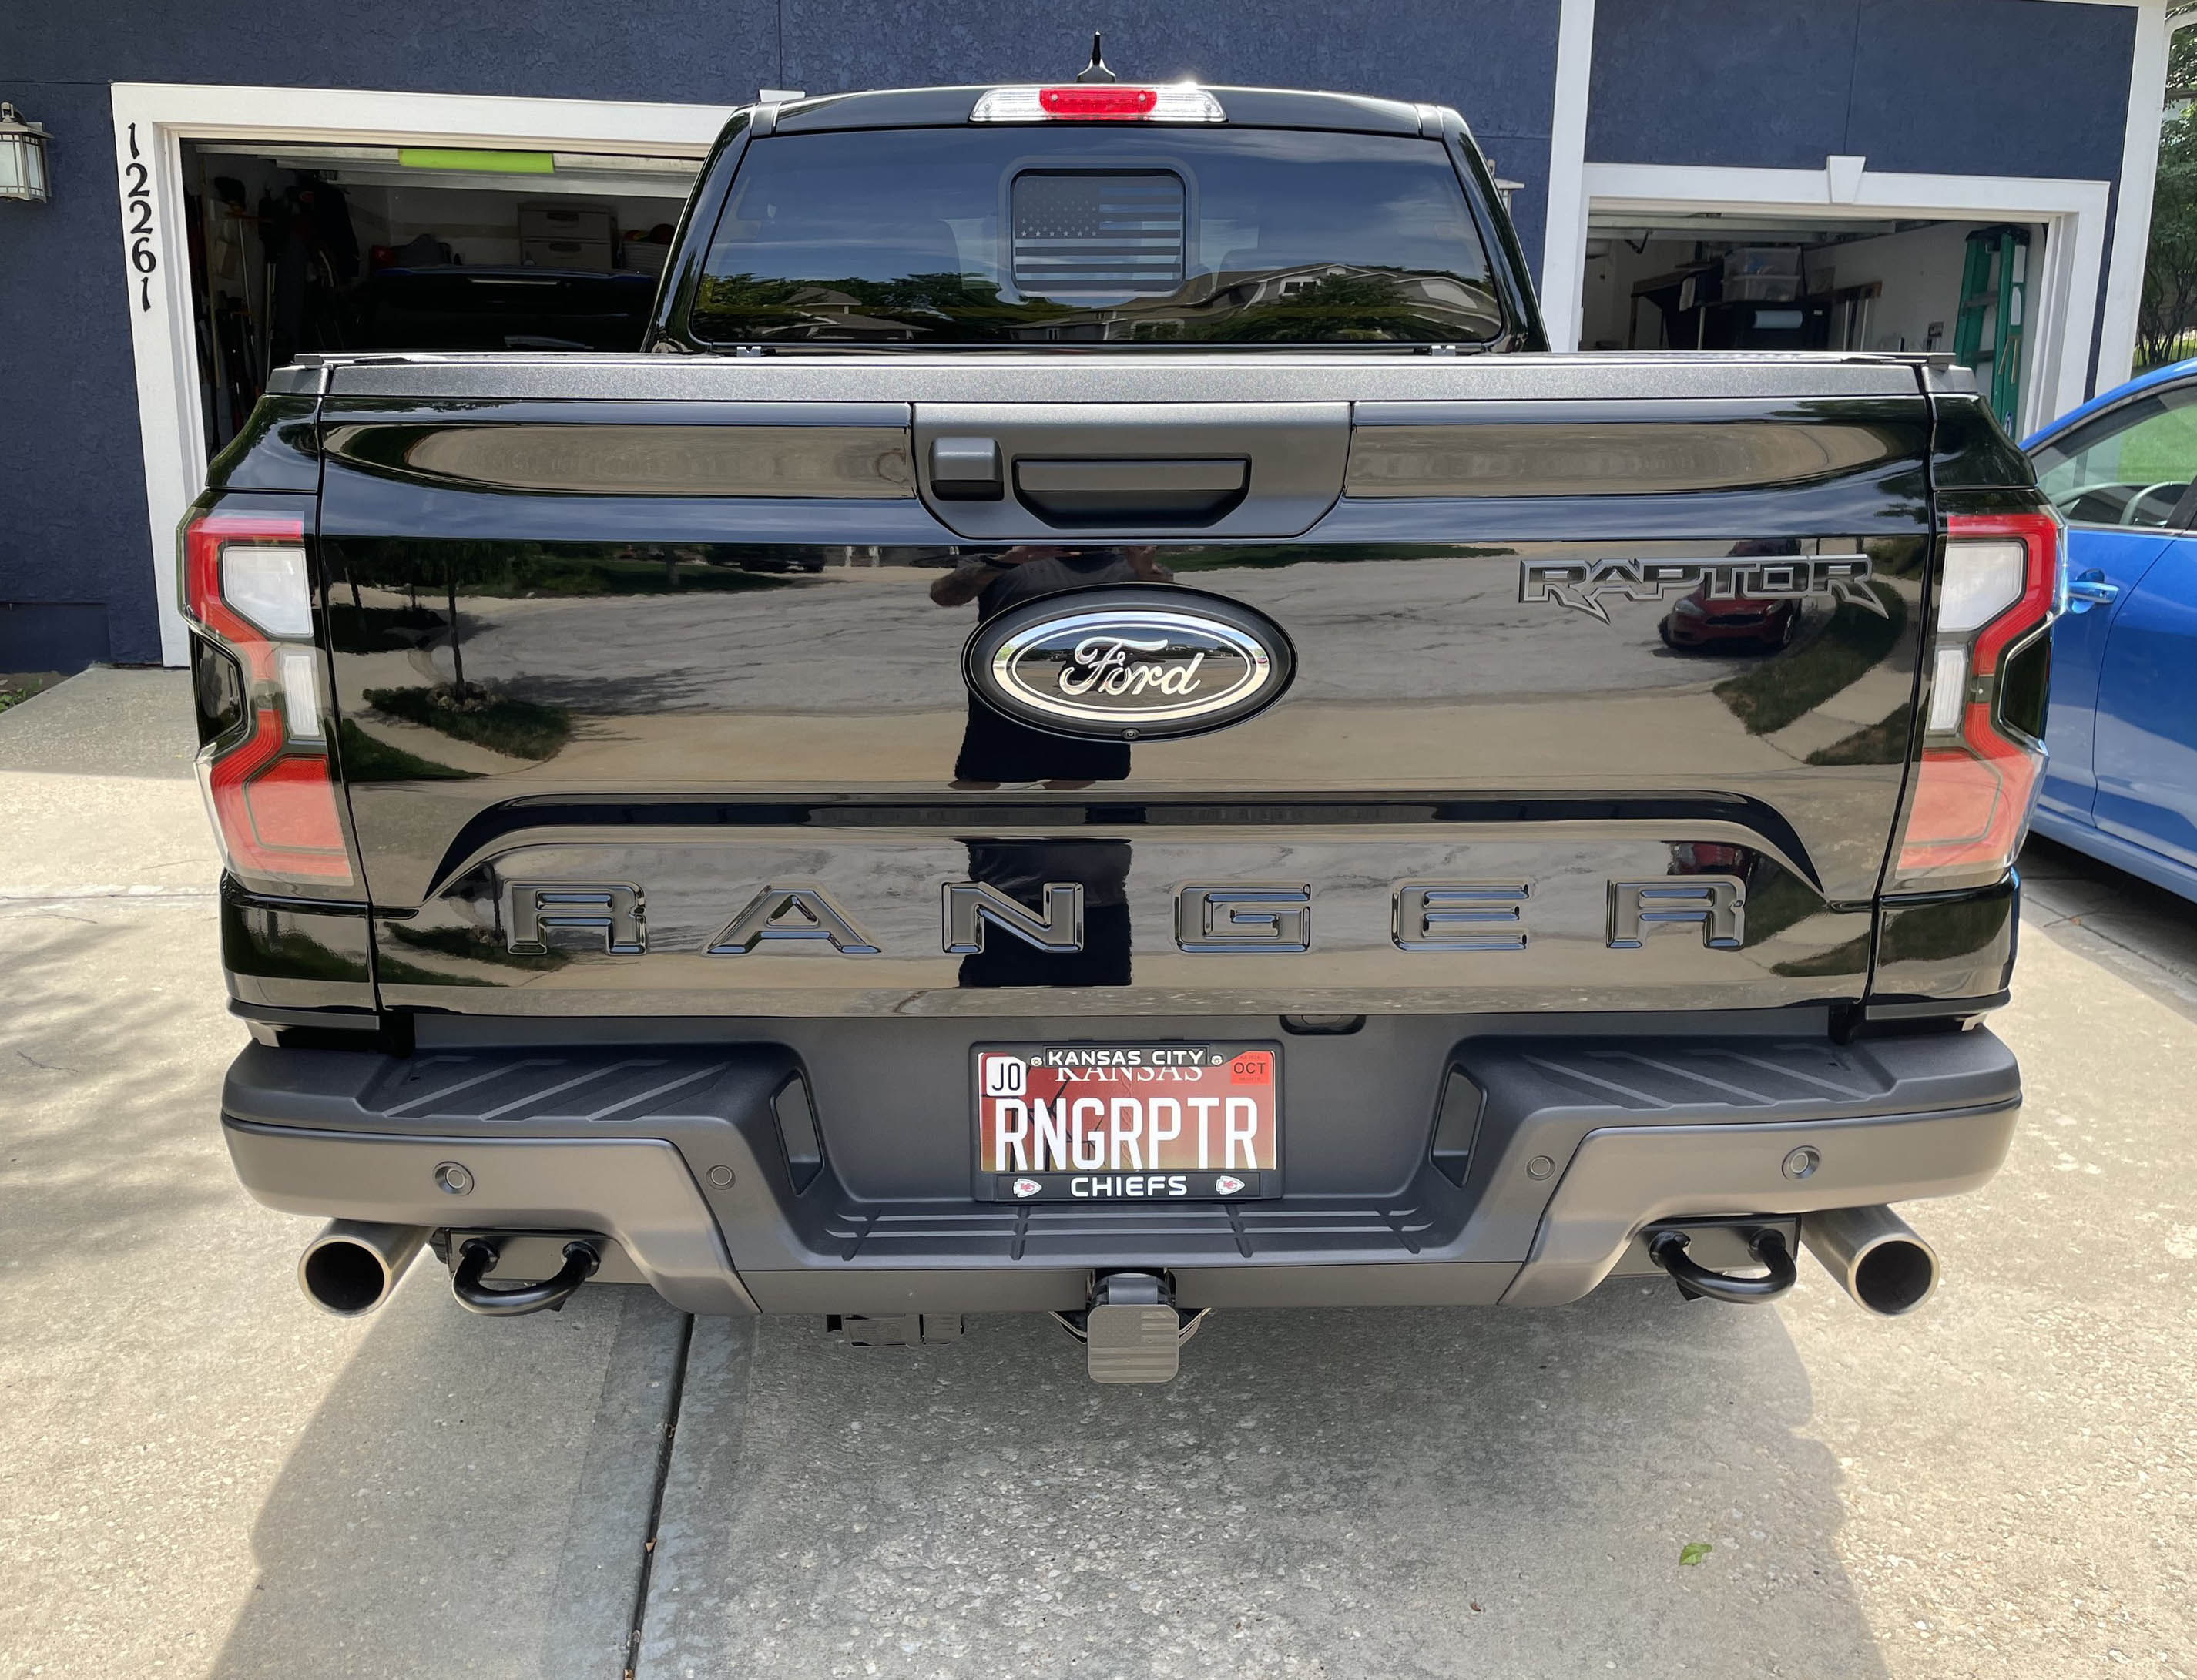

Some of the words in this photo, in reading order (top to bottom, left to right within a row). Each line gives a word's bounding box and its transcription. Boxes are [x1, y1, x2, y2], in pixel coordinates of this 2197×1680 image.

[126, 122, 156, 312] 12261
[1519, 553, 1890, 625] RAPTOR
[1059, 636, 1205, 696] Ford
[505, 877, 1746, 955] RANGER
[1048, 1051, 1141, 1065] KANSAS
[1152, 1050, 1204, 1065] CITY
[1233, 1062, 1266, 1075] OCT
[995, 1097, 1258, 1172] RNGRPTR
[1070, 1175, 1187, 1197] CHIEFS
